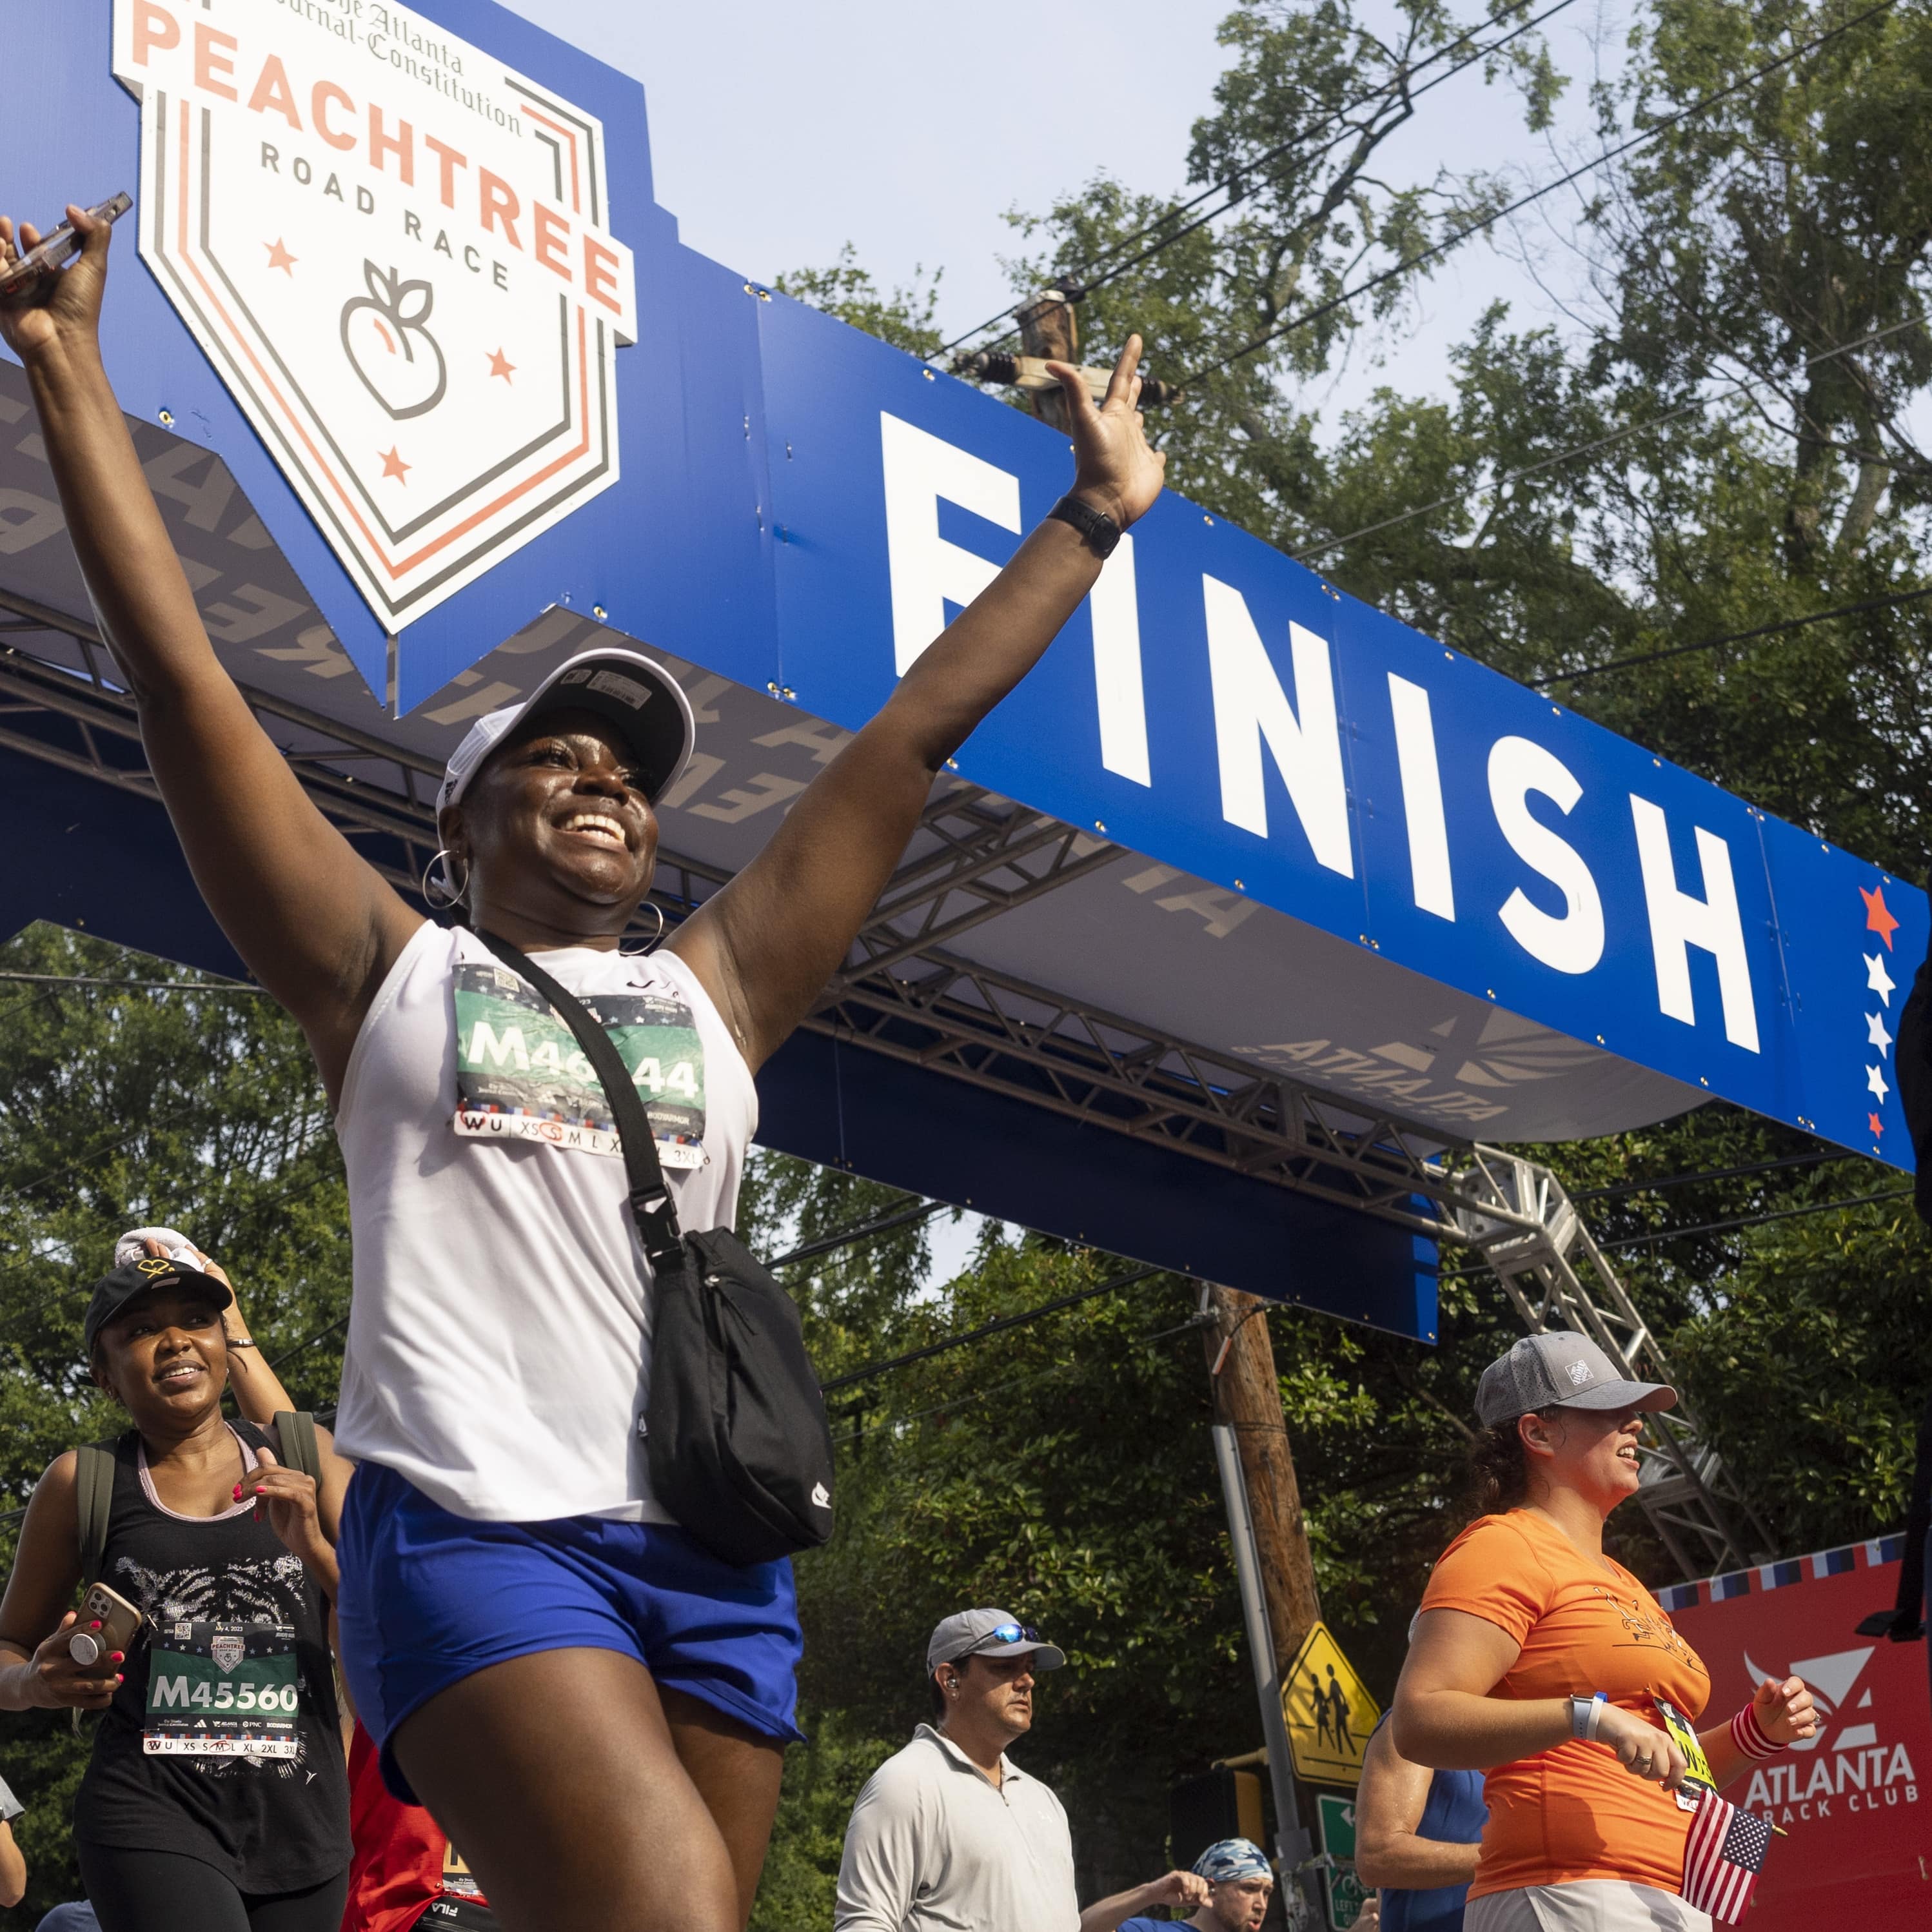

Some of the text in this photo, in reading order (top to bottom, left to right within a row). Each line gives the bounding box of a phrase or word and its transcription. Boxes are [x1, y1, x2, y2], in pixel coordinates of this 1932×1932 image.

[370, 3, 464, 76] Atlanta
[132, 0, 623, 316] PEACHTREE
[261, 141, 509, 292] ROAD RACE
[881, 411, 1760, 1054] FINISH
[468, 1021, 699, 1098] M4644
[464, 1116, 484, 1130] W
[491, 1119, 502, 1132] U
[520, 1121, 539, 1135] XS
[550, 1128, 559, 1139] S
[569, 1131, 581, 1145] M
[592, 1135, 598, 1148] L
[674, 1150, 698, 1165] 3XL
[152, 1675, 299, 1712] M45560
[149, 1742, 161, 1750] W
[183, 1742, 195, 1751] XS
[202, 1742, 208, 1751] S
[215, 1743, 225, 1751] M
[231, 1743, 236, 1751] L
[243, 1744, 255, 1752] XL
[261, 1744, 277, 1754] 2XL
[284, 1745, 295, 1755] 3XL
[1744, 1743, 1916, 1809] ATLANTA
[1752, 1785, 1918, 1824] RACK CLUB
[431, 1902, 458, 1917] FILA
